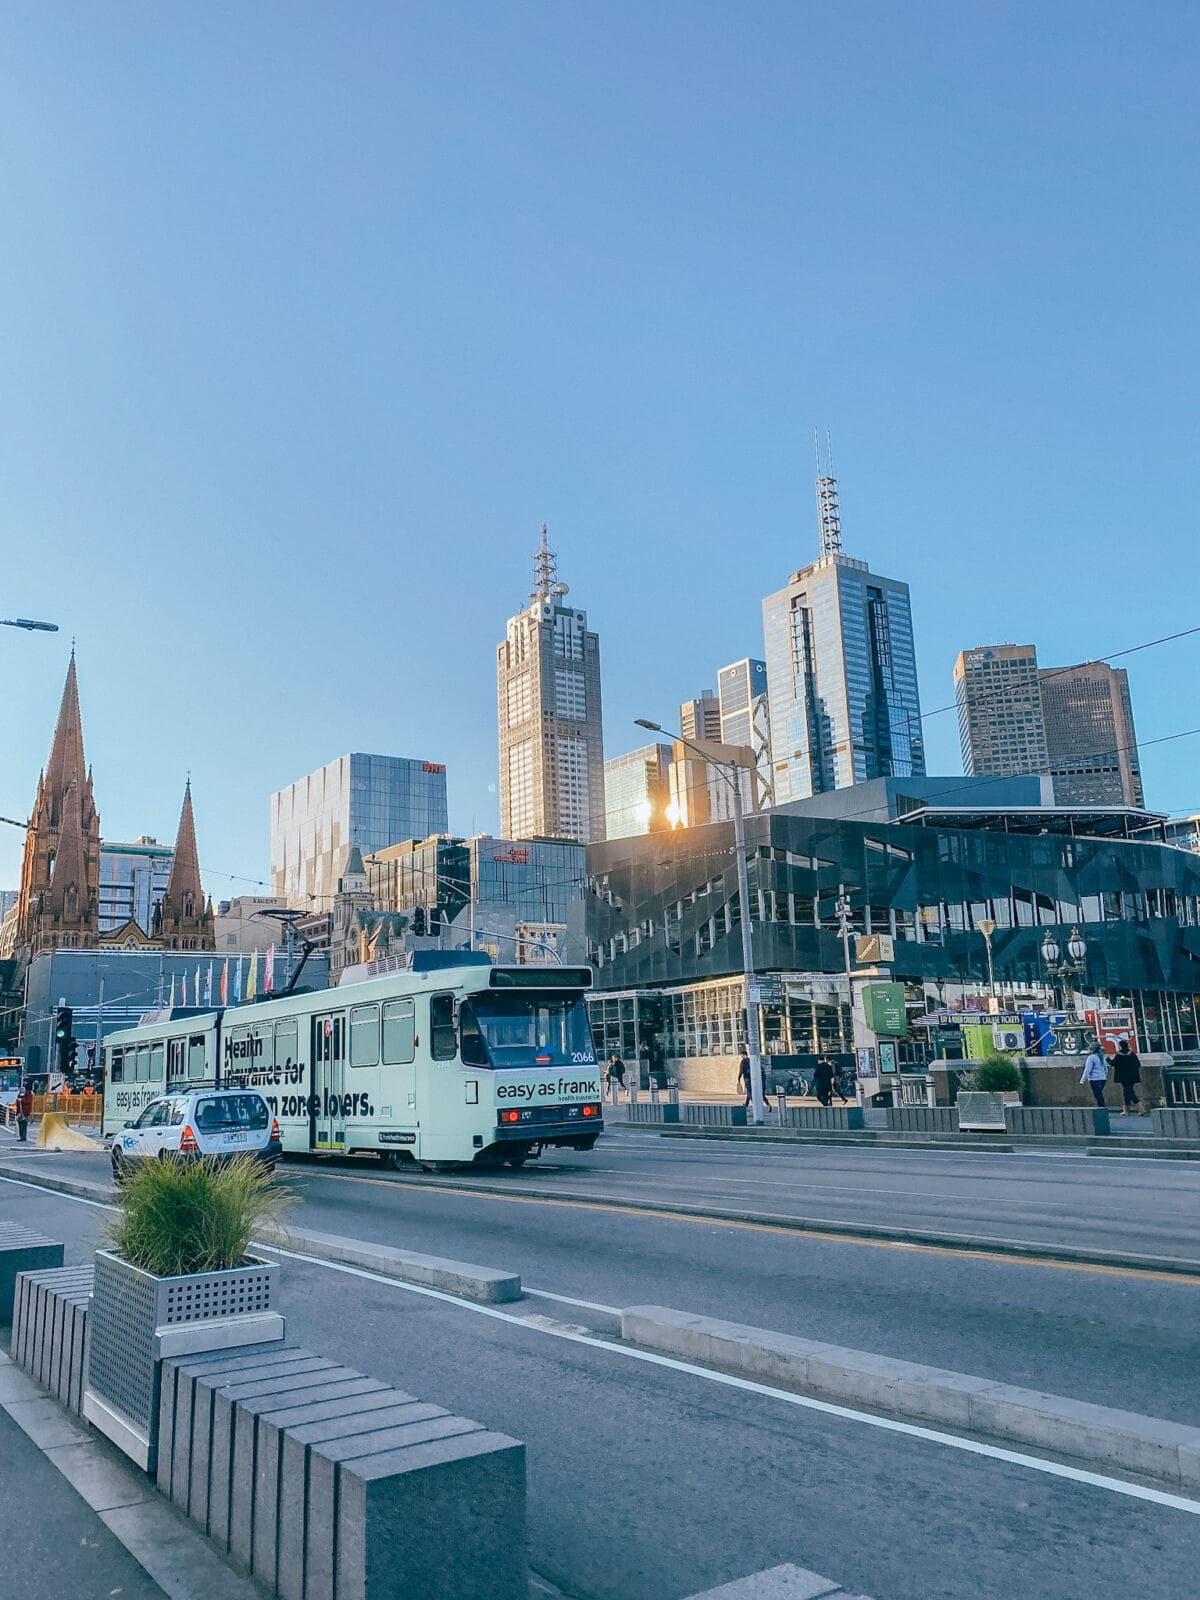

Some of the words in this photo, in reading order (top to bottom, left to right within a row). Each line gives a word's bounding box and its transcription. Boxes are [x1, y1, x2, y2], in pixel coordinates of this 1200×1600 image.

[967, 653, 985, 661] ANZ
[423, 762, 446, 774] BHP
[982, 1015, 1001, 1024] CRUSE
[1001, 1014, 1020, 1024] TICKETS
[225, 1031, 263, 1059] Health
[571, 1052, 594, 1063] 2066
[285, 1057, 305, 1085] for
[497, 1084, 536, 1101] easy
[538, 1083, 556, 1095] as
[558, 1078, 600, 1095] frank.
[117, 1090, 131, 1112] easy
[131, 1091, 141, 1107] as
[282, 1094, 322, 1117] zone
